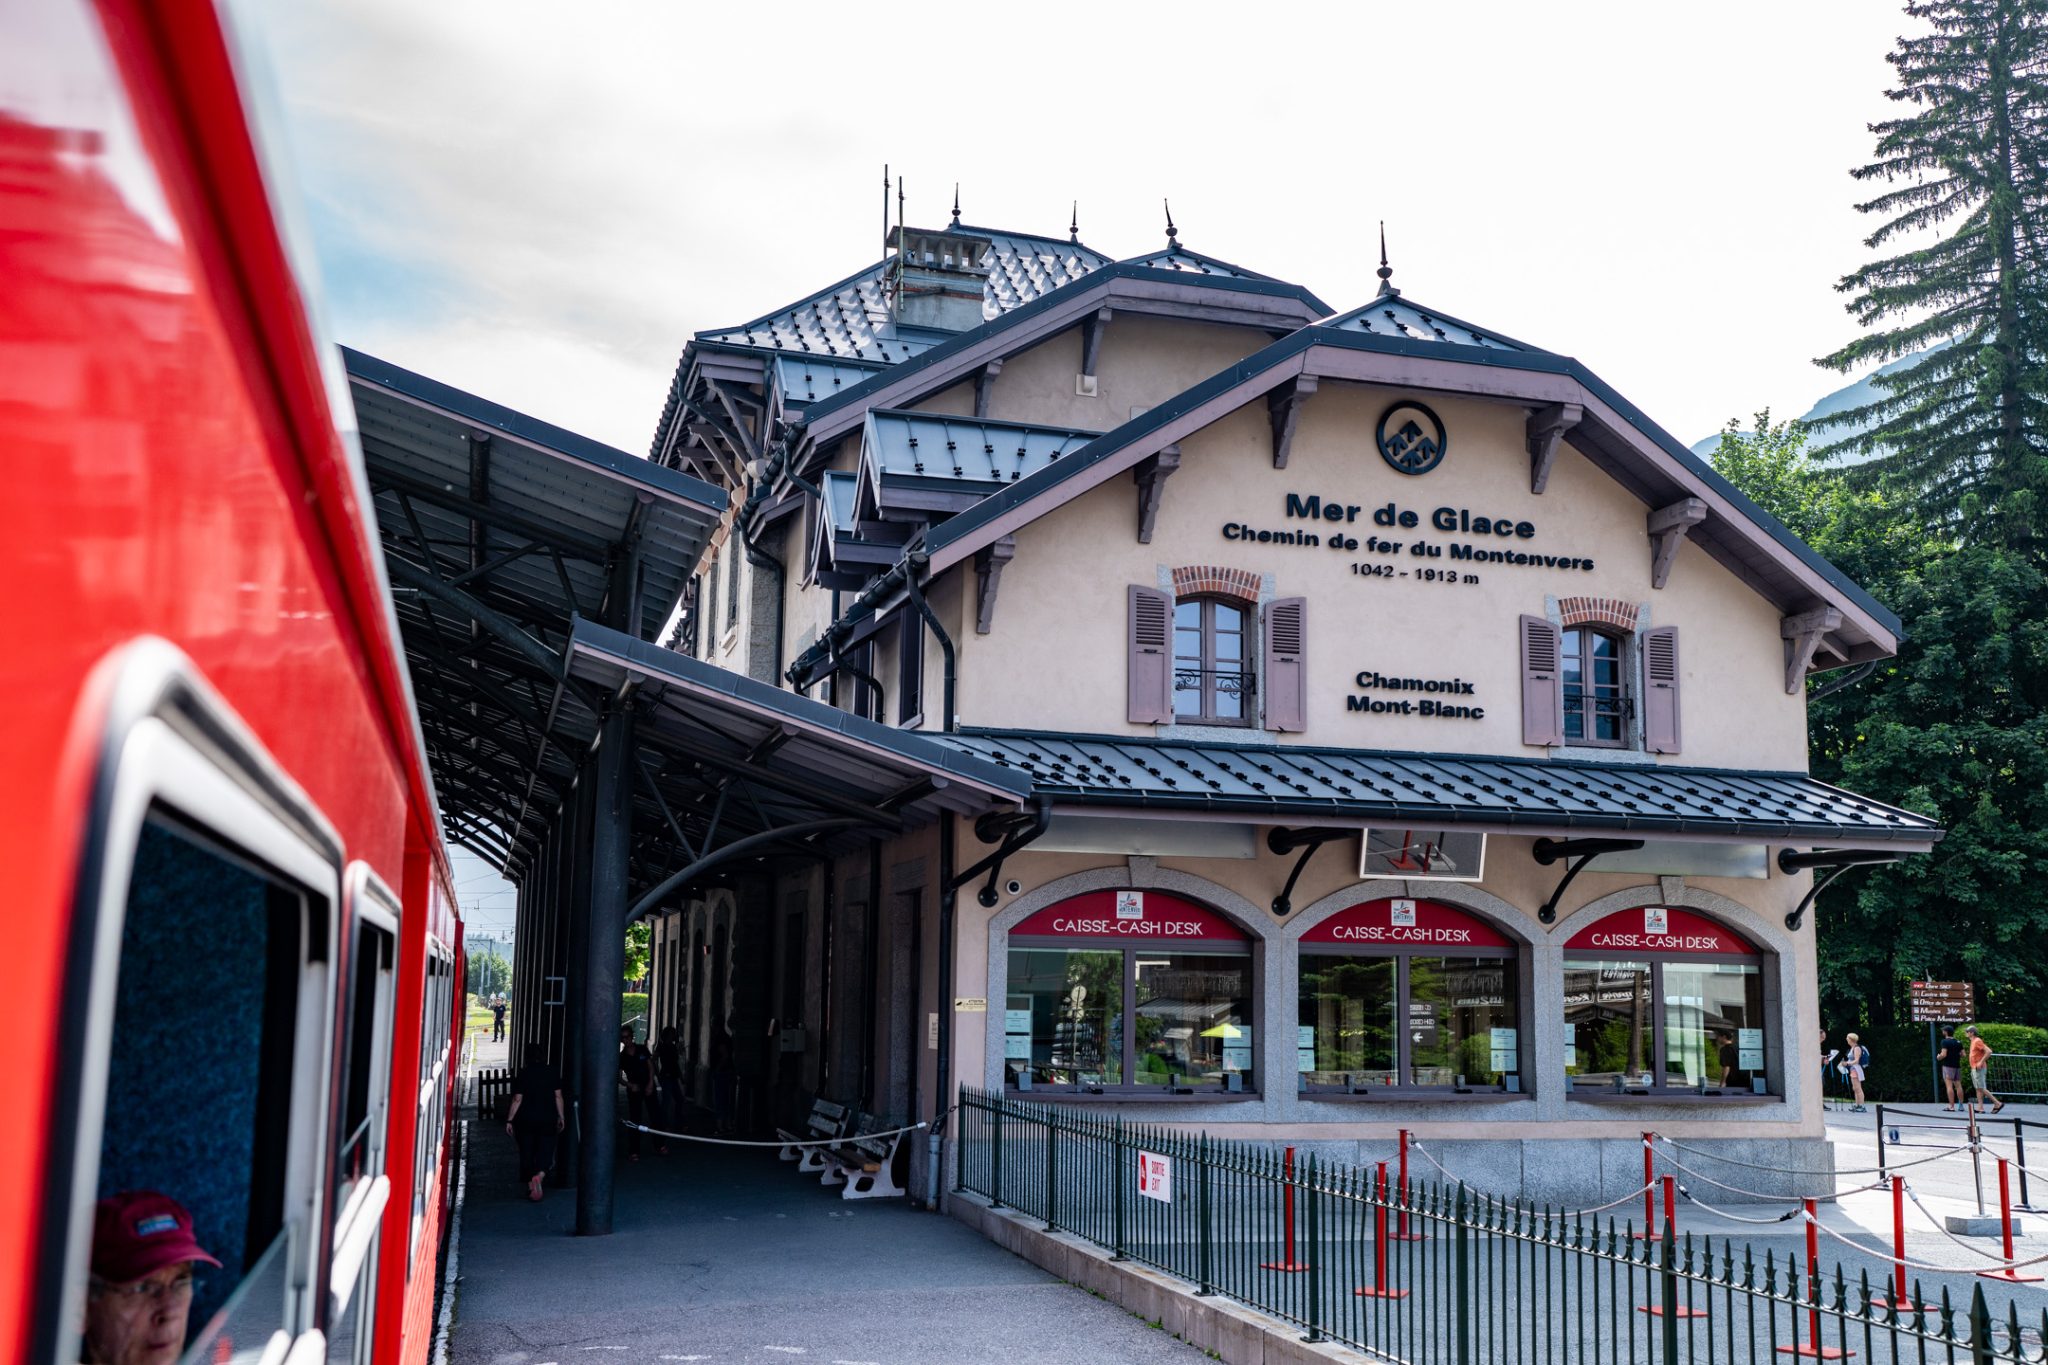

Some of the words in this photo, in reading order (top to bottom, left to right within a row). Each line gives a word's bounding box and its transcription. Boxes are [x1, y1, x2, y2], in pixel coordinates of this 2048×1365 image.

[1286, 493, 1361, 523] Mer
[1374, 503, 1419, 528] de
[1432, 507, 1535, 538] Glace
[1222, 522, 1319, 546] Chemin
[1328, 533, 1358, 551] de
[1366, 536, 1402, 554] fer
[1410, 541, 1441, 557] du
[1450, 543, 1594, 571] Montenvers
[1351, 562, 1394, 578] 1042
[1415, 568, 1457, 583] 1913
[1463, 574, 1479, 585] m
[1356, 671, 1474, 694] Chamonix
[1347, 695, 1484, 720] Mont-Blanc
[1053, 918, 1161, 934] CAISSE-CASH
[1165, 921, 1203, 935] DESK
[1333, 926, 1432, 941] CAISSE-CASH
[1436, 929, 1471, 942] DESK
[1592, 933, 1682, 948] CAISSE-CASH
[1686, 936, 1719, 949] DESK
